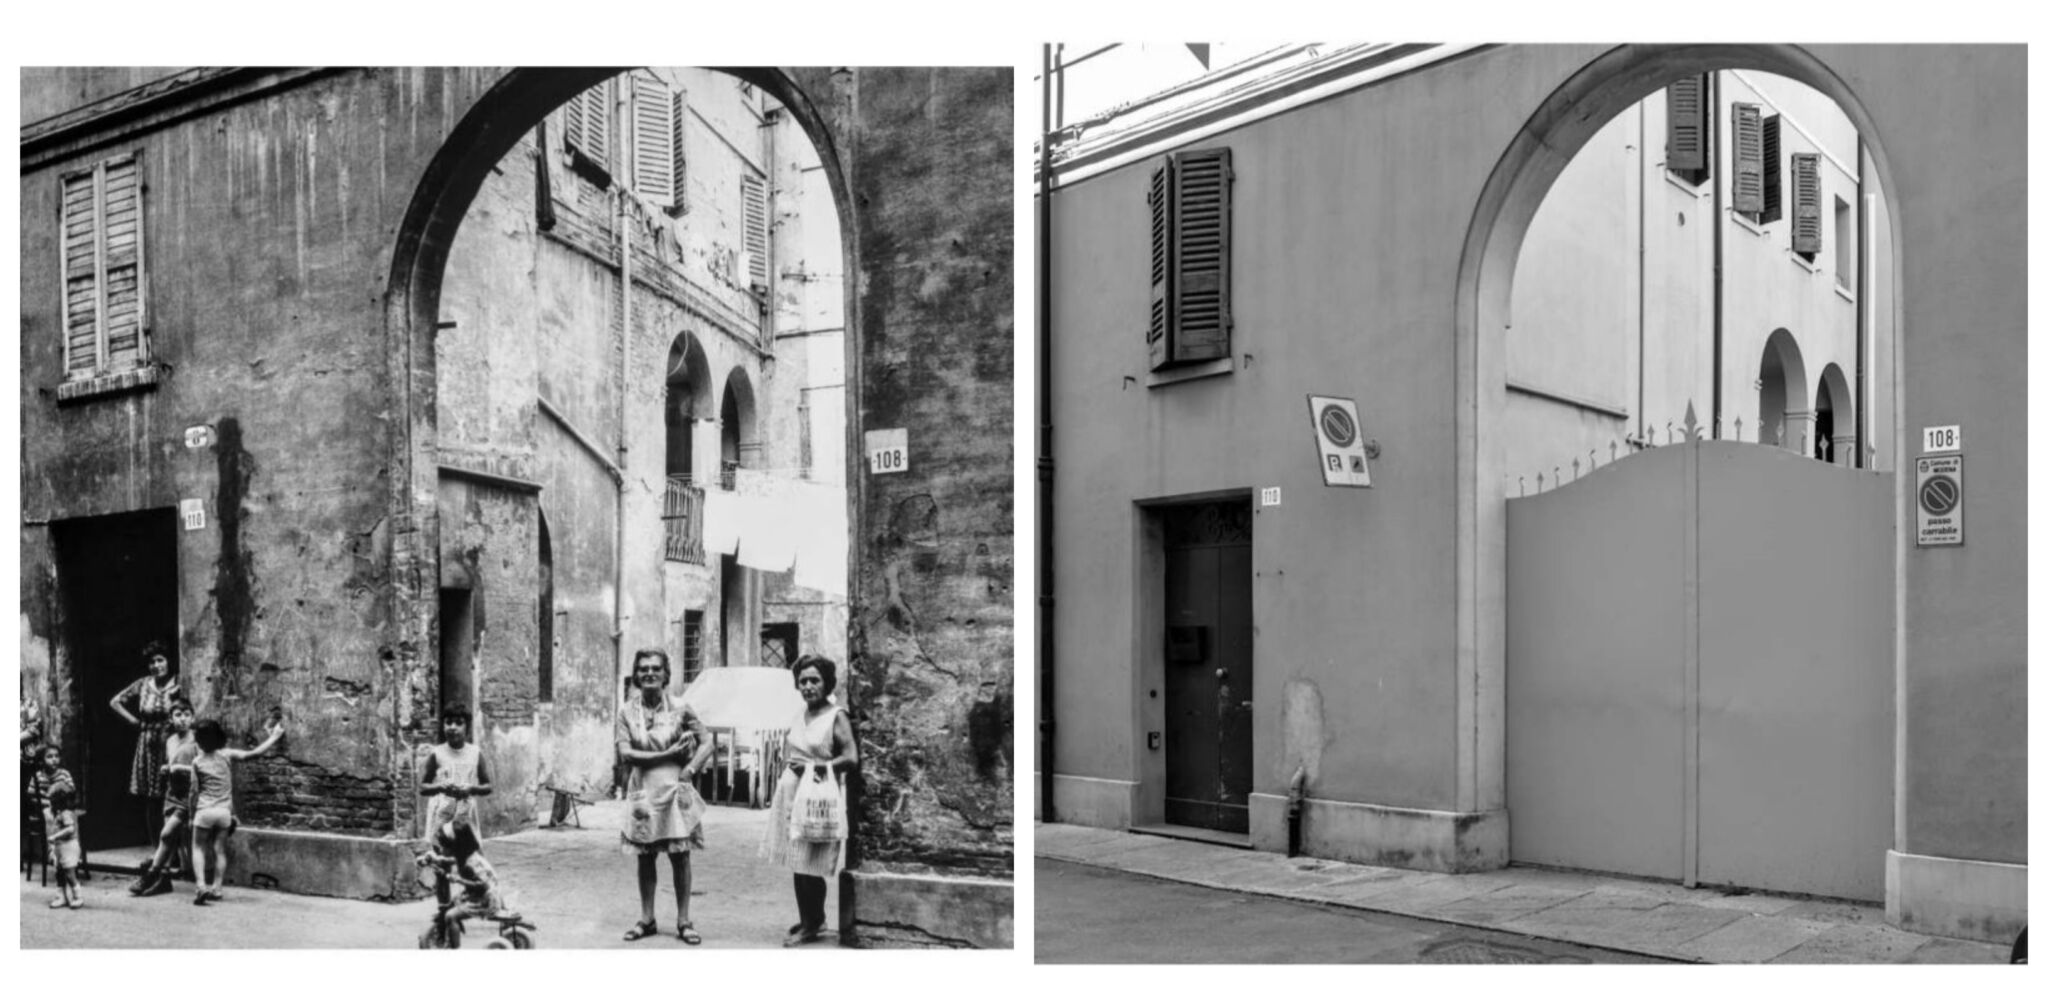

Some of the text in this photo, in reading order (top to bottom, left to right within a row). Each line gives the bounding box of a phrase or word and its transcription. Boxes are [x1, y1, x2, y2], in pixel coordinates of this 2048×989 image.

[1929, 429, 1954, 448] 108
[876, 449, 902, 470] 108
[1264, 489, 1278, 504] 110
[187, 512, 202, 528] 110
[1927, 518, 1952, 526] passo
[1921, 526, 1957, 536] carrabile
